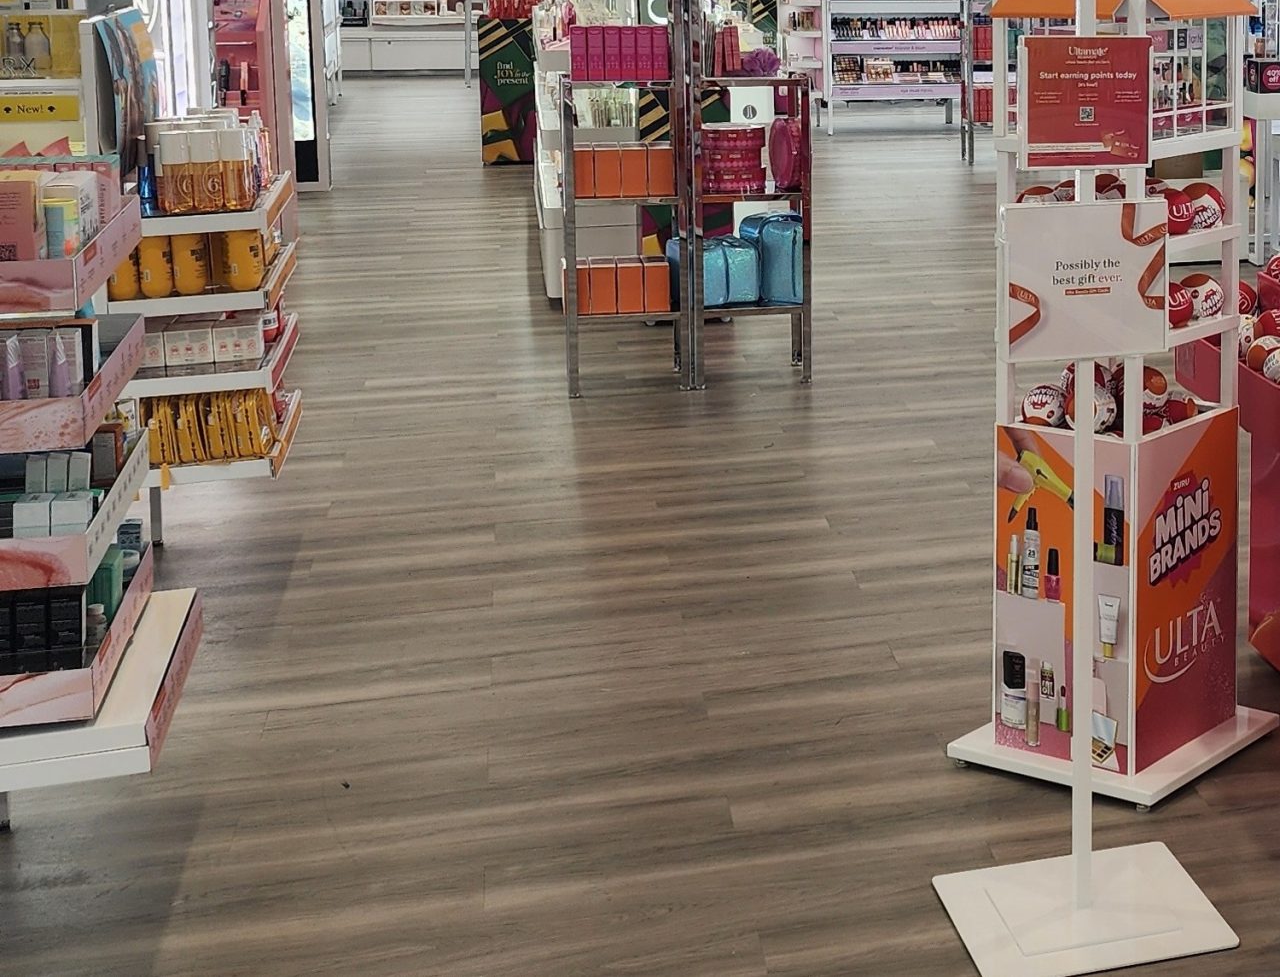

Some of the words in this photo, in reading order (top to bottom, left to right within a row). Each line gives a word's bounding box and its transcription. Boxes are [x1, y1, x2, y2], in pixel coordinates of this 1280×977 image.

[497, 61, 513, 70] find
[497, 77, 529, 86] present
[1060, 72, 1088, 80] earning
[1091, 72, 1113, 80] points
[1116, 72, 1136, 80] today
[17, 104, 44, 114] New!
[1055, 259, 1101, 271] Possibly
[1103, 258, 1120, 268] the
[1052, 275, 1075, 285] best
[1078, 274, 1096, 286] gift
[1098, 274, 1123, 283] ever.
[1173, 477, 1190, 491] ZURU
[1151, 509, 1222, 579] BRANDS
[1154, 603, 1222, 665] ULTA
[1174, 633, 1226, 666] BEAUTY
